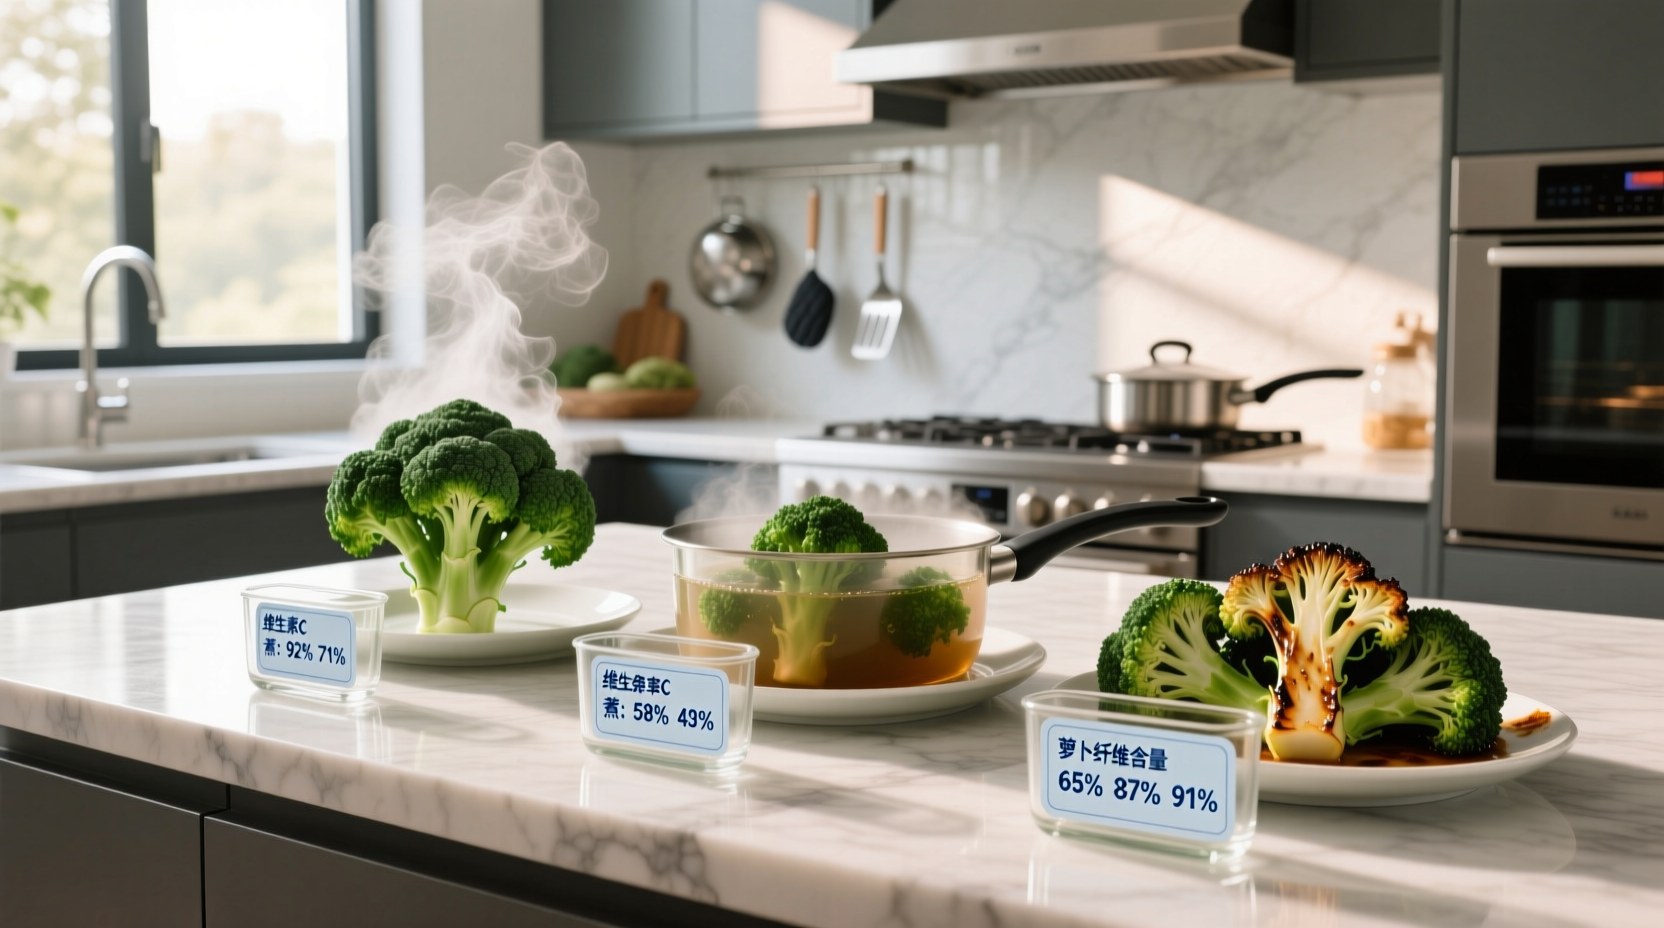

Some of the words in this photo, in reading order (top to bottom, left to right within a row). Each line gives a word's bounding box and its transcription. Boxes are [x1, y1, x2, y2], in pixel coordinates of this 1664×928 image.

[286, 641, 313, 661] 92%
[318, 645, 346, 666] 71%
[633, 702, 669, 725] 58%
[677, 708, 716, 731] 49%
[1058, 737, 1168, 771] 萝卜纤维含量
[1058, 770, 1103, 797] 65%
[1113, 777, 1161, 805] 87%
[1172, 785, 1218, 813] 91%
